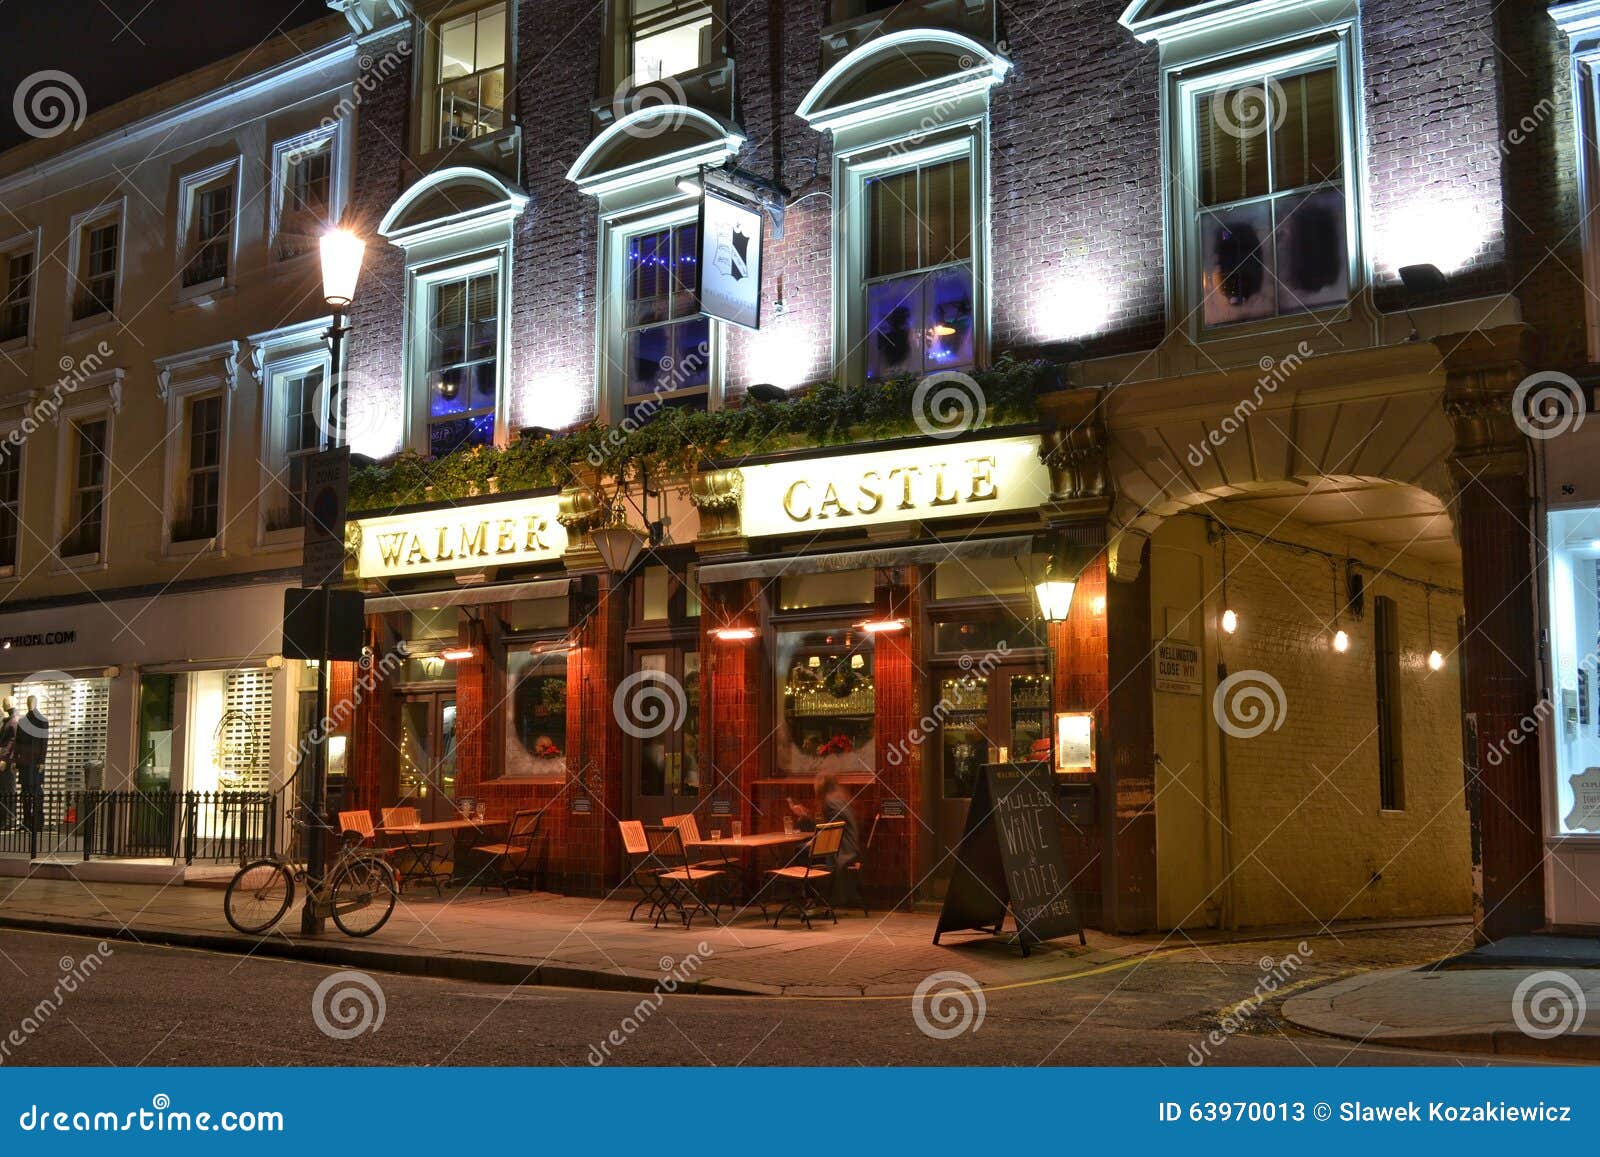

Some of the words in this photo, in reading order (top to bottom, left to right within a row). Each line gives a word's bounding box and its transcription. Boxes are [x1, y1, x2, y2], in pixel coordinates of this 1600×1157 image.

[783, 455, 998, 523] CASTLE
[376, 515, 550, 567] WALMER
[1159, 646, 1198, 664] WELLINGTON
[1160, 661, 1180, 676] CLOSE
[1011, 863, 1064, 902] CIDER
